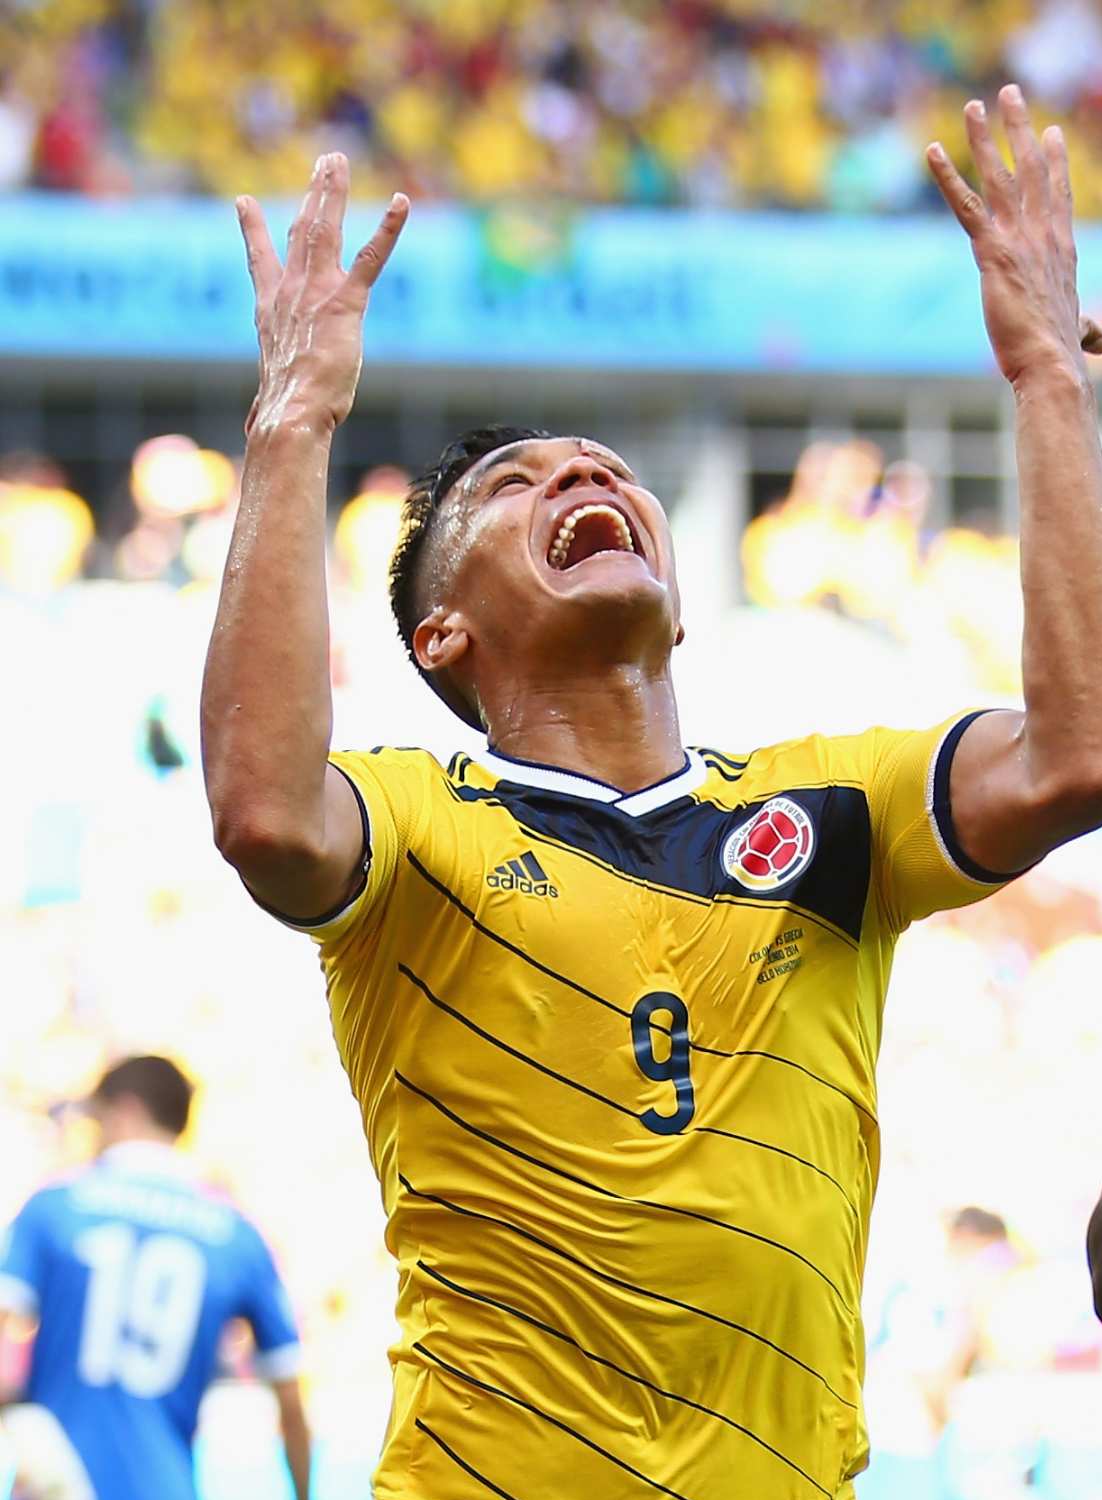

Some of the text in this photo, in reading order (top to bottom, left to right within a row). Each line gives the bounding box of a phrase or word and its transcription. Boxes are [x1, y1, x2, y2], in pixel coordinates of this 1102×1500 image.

[487, 873, 559, 900] adidas
[630, 991, 695, 1135] 9
[74, 1221, 208, 1400] 19
